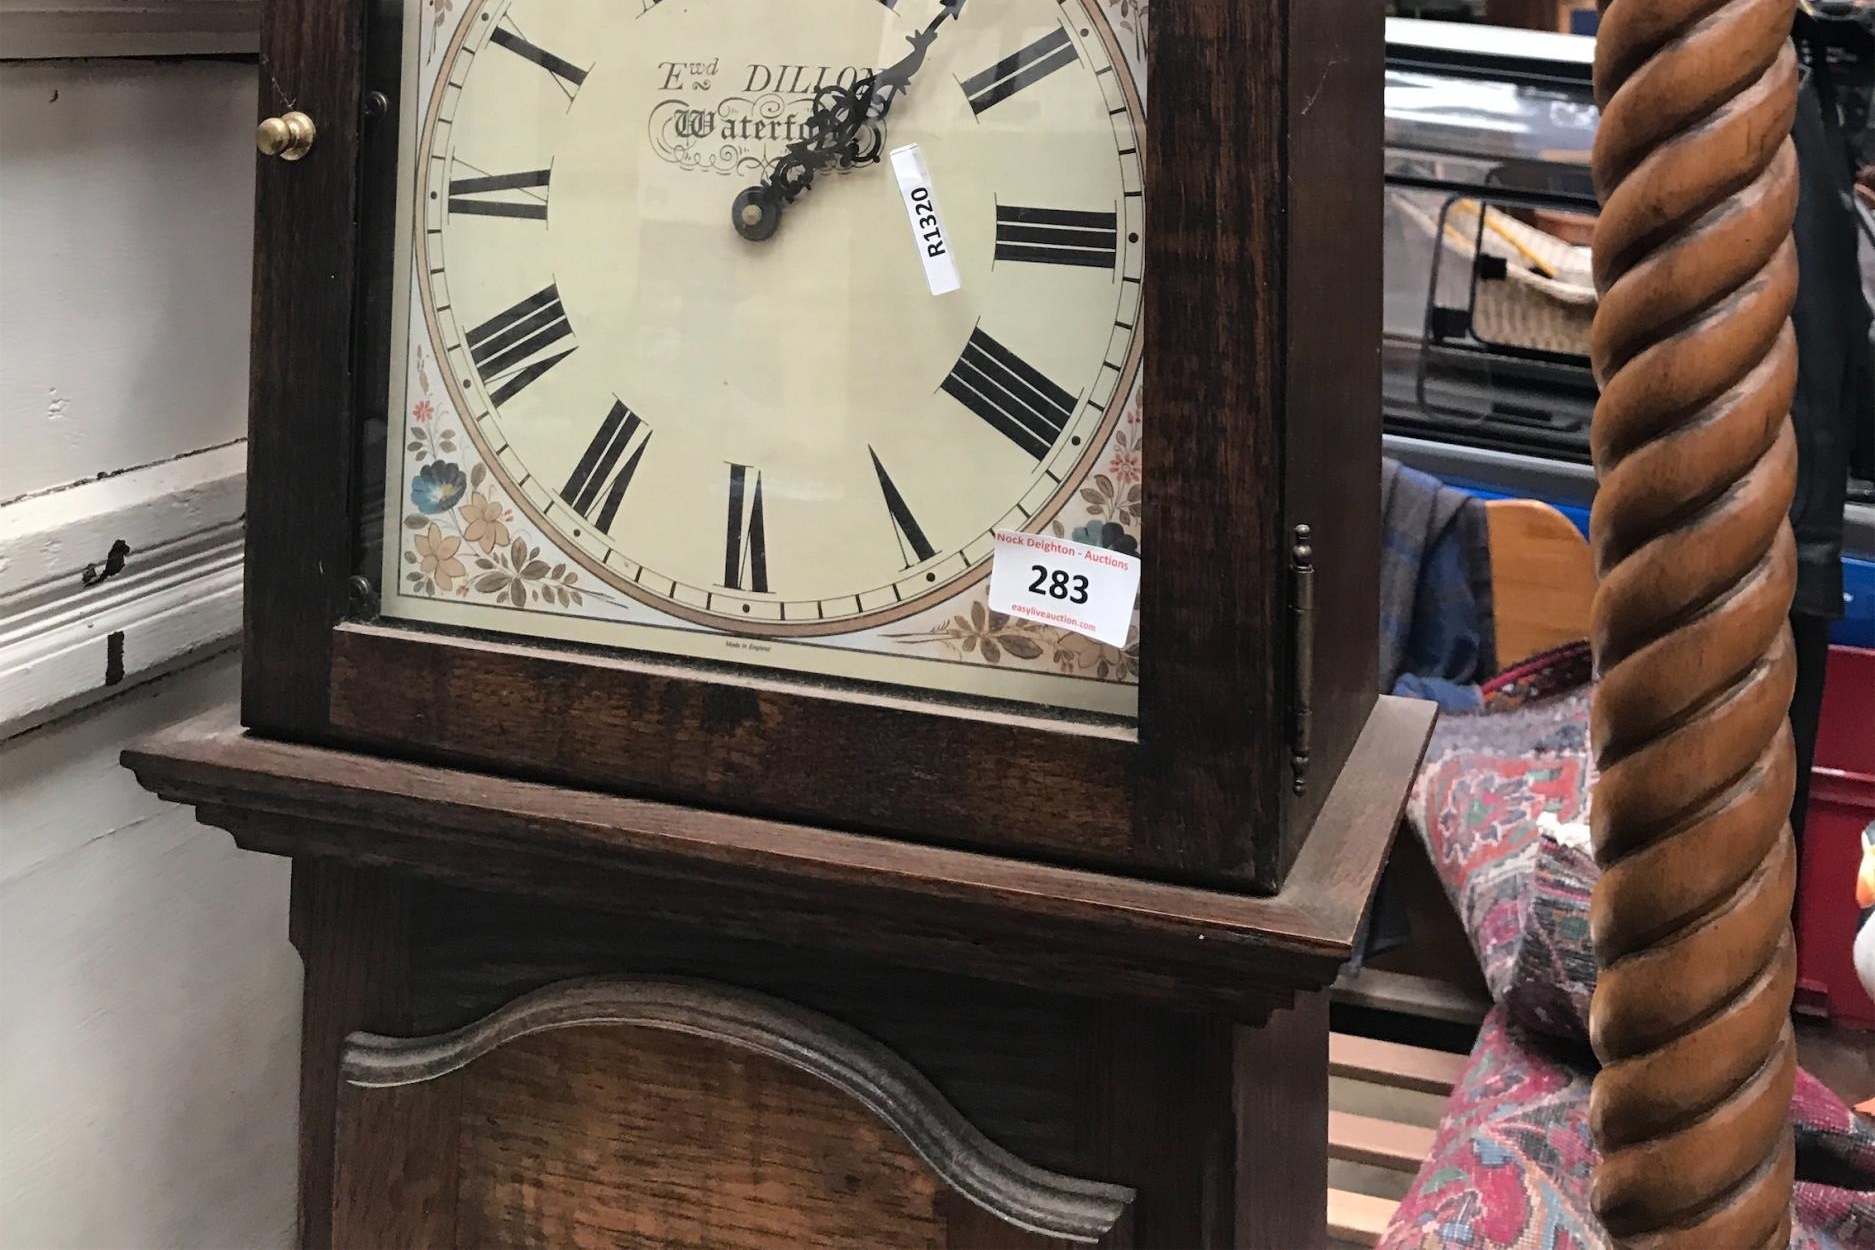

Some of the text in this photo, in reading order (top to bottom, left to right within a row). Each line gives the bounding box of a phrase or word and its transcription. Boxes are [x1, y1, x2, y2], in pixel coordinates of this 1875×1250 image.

[485, 2, 595, 114] X
[953, 17, 1085, 124] II
[673, 108, 842, 148] Waterfo
[447, 146, 554, 230] IX
[911, 187, 946, 258] R1320
[992, 193, 1117, 283] III
[462, 273, 579, 418] VIII
[934, 316, 1084, 473] IIII
[552, 392, 653, 541] VII
[868, 444, 942, 572] V
[713, 461, 776, 594] VI
[996, 533, 1024, 546] Nock
[1026, 538, 1075, 557] Deighton
[1084, 550, 1129, 571] Auctions
[1011, 604, 1096, 632] easyliveauction.com
[1028, 564, 1089, 604] 283
